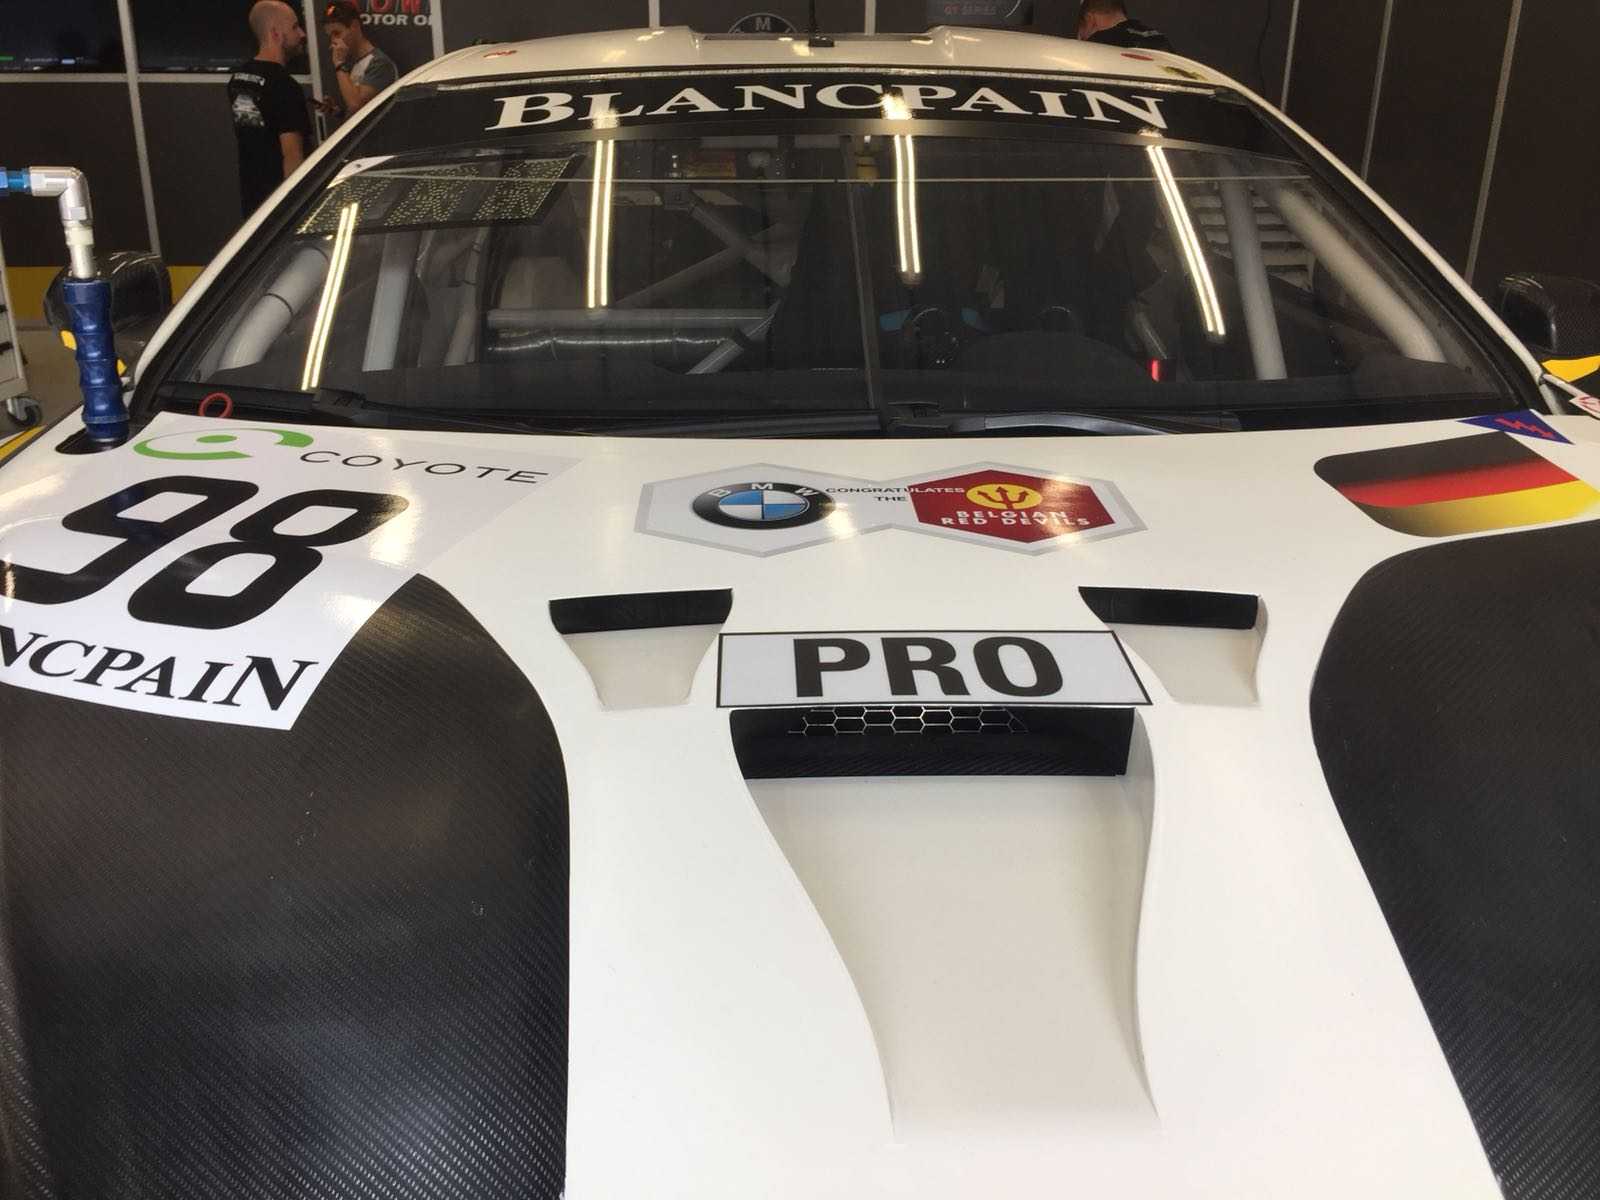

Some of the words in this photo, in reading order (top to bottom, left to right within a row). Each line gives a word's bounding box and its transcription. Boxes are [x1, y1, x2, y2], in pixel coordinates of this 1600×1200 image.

[484, 83, 1168, 131] BLANCPAIN
[300, 450, 548, 484] COYOTE
[709, 482, 819, 498] BMW
[941, 517, 988, 525] RED
[1002, 517, 1091, 526] DEVILS
[0, 475, 409, 630] 98
[793, 635, 1064, 698] PRO
